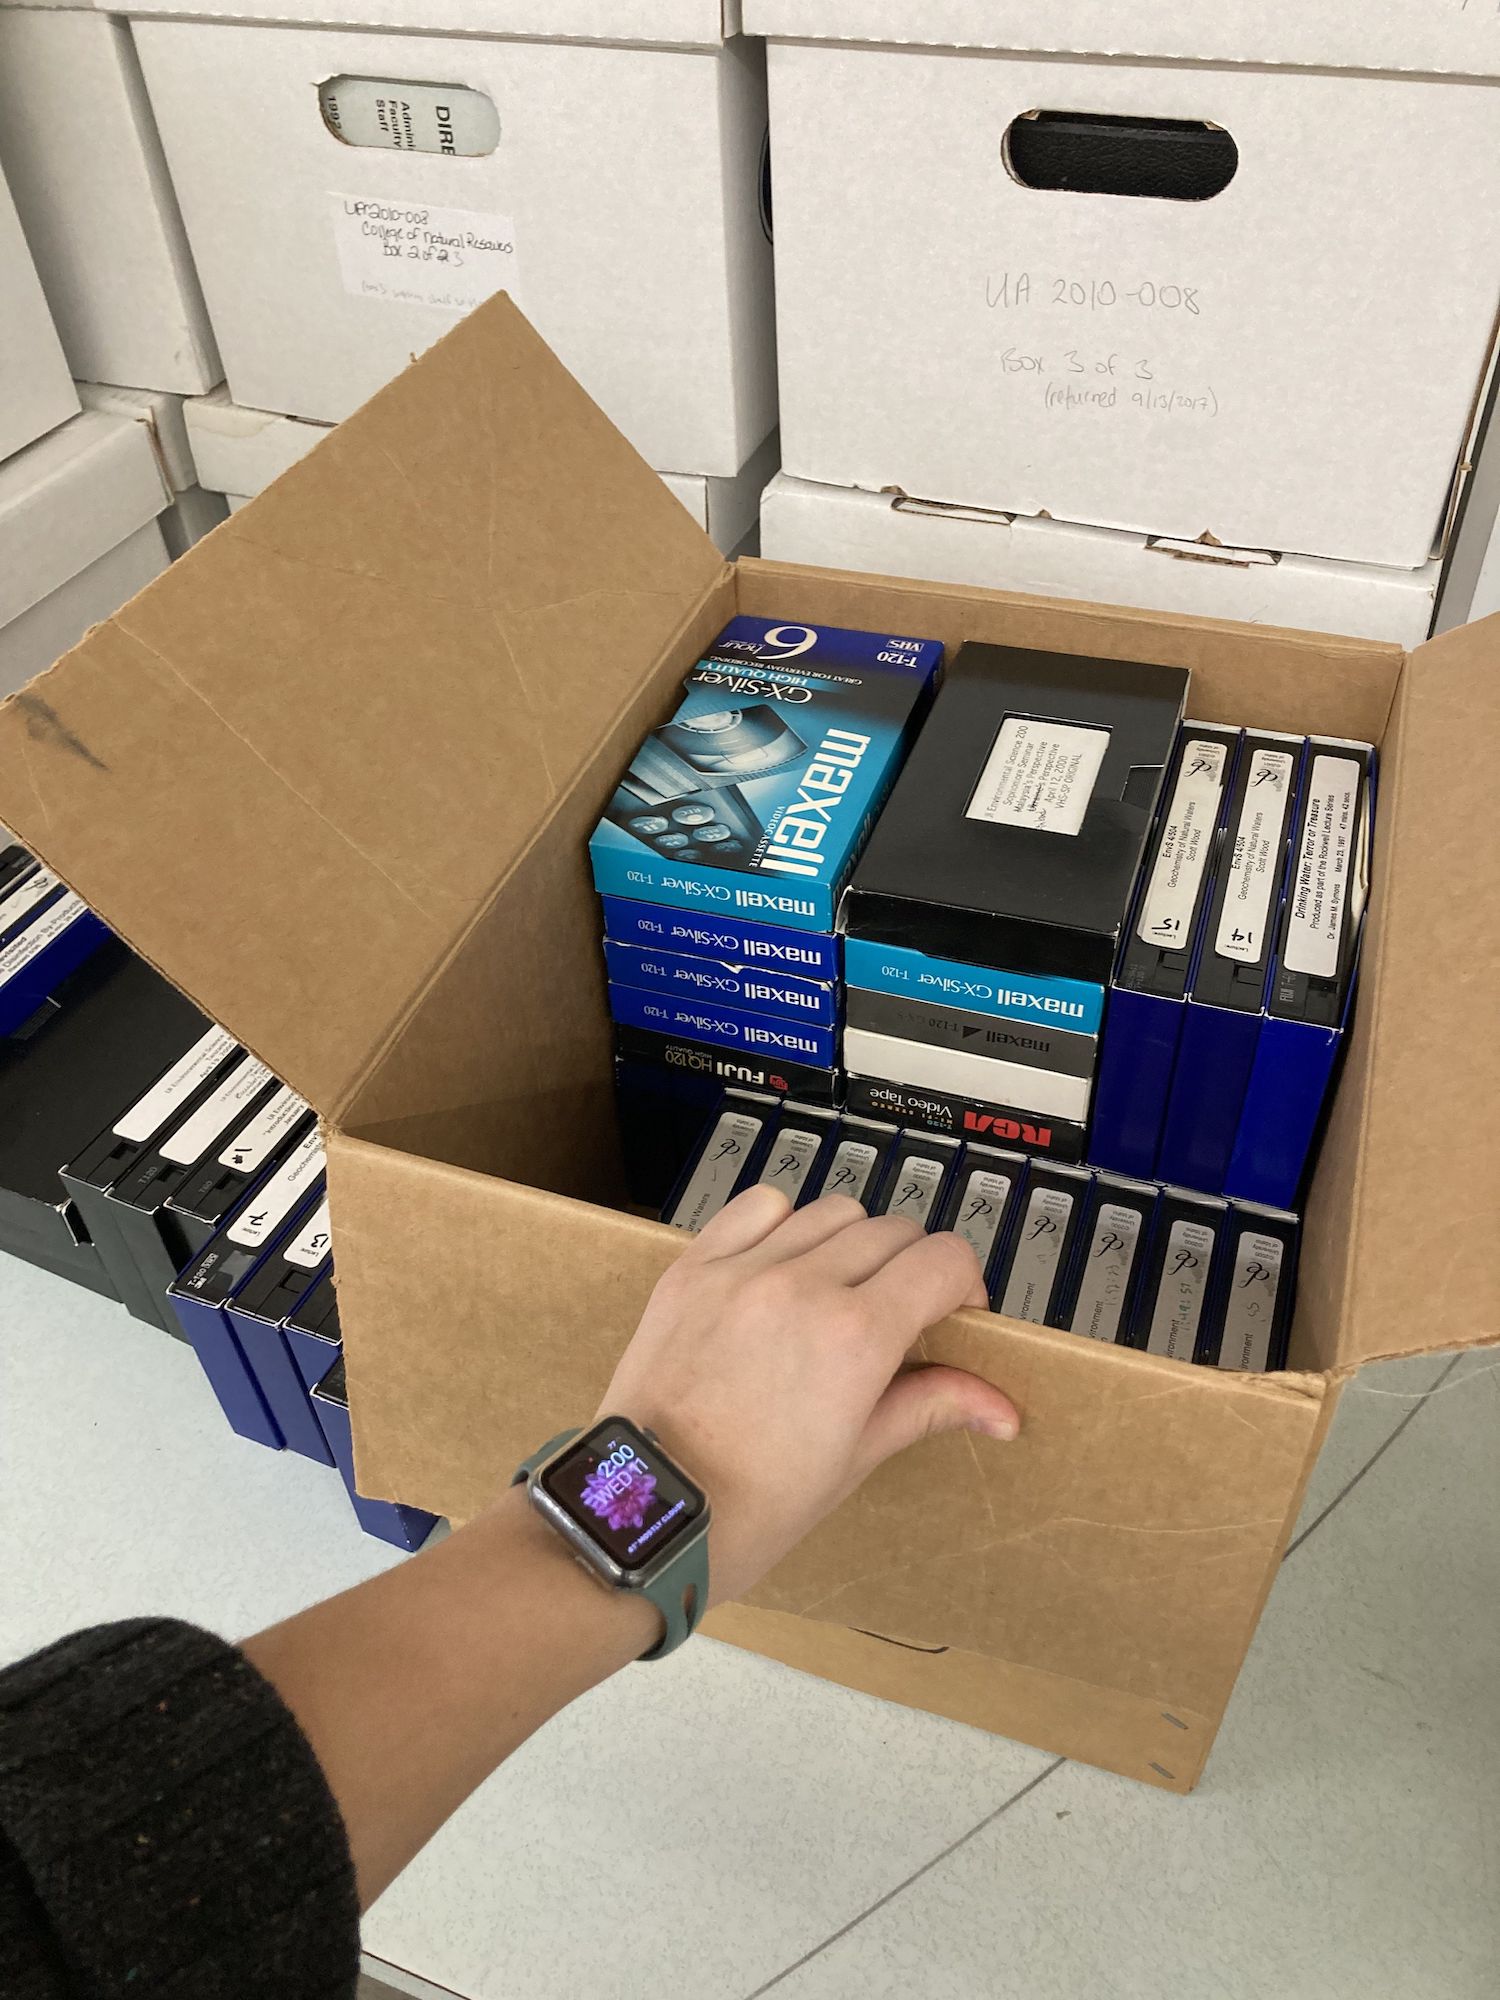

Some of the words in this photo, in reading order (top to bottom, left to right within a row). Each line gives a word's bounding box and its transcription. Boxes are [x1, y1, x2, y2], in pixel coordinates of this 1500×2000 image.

[376, 99, 389, 131] Staff
[388, 100, 401, 148] Faculty
[361, 220, 403, 242] College
[406, 227, 421, 240] of
[407, 246, 421, 260] 2
[986, 272, 1031, 308] UA
[1051, 278, 1200, 315] 2010-008
[1000, 346, 1045, 375] Box
[1063, 350, 1085, 374] 3
[1095, 353, 1118, 375] of
[1135, 359, 1154, 380] 3
[1044, 382, 1118, 409] (returned
[718, 640, 764, 656] hour
[756, 625, 818, 660] 6
[887, 639, 922, 652] VHS
[703, 661, 767, 679] QUALITY
[709, 655, 764, 668] RECORDING
[765, 663, 811, 677] EVERYDAY
[876, 650, 918, 668] T-120
[766, 671, 808, 686] HIGH
[811, 671, 831, 680] FOR
[831, 675, 863, 686] GREAT
[690, 670, 813, 704] GX-Silver
[1005, 739, 1023, 765] Science
[1014, 725, 1028, 739] 200
[1017, 742, 1034, 767] Seminar
[1038, 743, 1062, 780] Perspective
[1053, 755, 1068, 773] 2000
[1062, 753, 1083, 783] ORIGINAL
[1013, 779, 1035, 812] Malaysia's
[1025, 740, 1049, 779] Perspective
[759, 728, 872, 878] maxell
[1182, 800, 1196, 820] Waters
[1306, 797, 1322, 827] Treasure
[1324, 794, 1335, 811] Series
[1178, 821, 1190, 841] Natural
[1251, 811, 1264, 831] Waters
[1322, 812, 1334, 833] Lecture
[748, 805, 785, 868] VIDEOCASSETTE
[1189, 828, 1201, 845] Wood
[1247, 832, 1260, 852] Natural
[1307, 828, 1316, 837] or
[1162, 841, 1174, 857] EnvS
[1185, 846, 1197, 861] Scott
[1258, 839, 1271, 856] Wood
[1302, 837, 1316, 859] Terror
[1317, 833, 1331, 859] Rockwell
[1166, 848, 1185, 888] Geochemistry
[1255, 857, 1267, 872] Scott
[1298, 861, 1312, 884] Water:
[1317, 859, 1327, 869] the
[1334, 856, 1344, 872] March
[626, 870, 653, 886] T-120
[660, 875, 731, 901] GX-Silver
[1236, 860, 1255, 900] Geochemistry
[1314, 877, 1327, 890] part
[735, 889, 816, 917] maxell
[1294, 886, 1310, 918] Drinking
[1314, 890, 1322, 898] as
[1330, 883, 1342, 904] Symons
[1151, 918, 1181, 931] 15
[1307, 899, 1324, 928] Produced
[1325, 912, 1338, 929] James
[637, 918, 664, 934] T-120
[1231, 928, 1252, 944] 14
[670, 925, 739, 950] GX-Silver
[743, 939, 822, 966] maxell
[641, 962, 668, 977] T-120
[673, 967, 740, 993] GX-Silver
[881, 965, 911, 980] T-120
[744, 982, 820, 1010] maxell
[916, 973, 993, 999] GX-Silver
[643, 1005, 669, 1020] T-120
[996, 988, 1084, 1019] maxell
[674, 1011, 739, 1036] GX-Silver
[928, 1018, 960, 1032] T-120
[743, 1026, 818, 1053] maxell
[985, 1030, 1050, 1052] maxell
[716, 1061, 765, 1085] FUJI
[869, 1087, 906, 1106] Tape
[907, 1096, 953, 1118] Video
[963, 1110, 1052, 1147] RCA
[691, 1192, 711, 1217] Waters
[243, 1209, 272, 1226] 7
[306, 1232, 332, 1248] 13
[596, 1444, 636, 1479] 2:00
[593, 1471, 634, 1506] WED
[627, 1456, 649, 1476] 11
[637, 1520, 663, 1544] MOSTLY
[661, 1498, 687, 1523] CLOUDY
